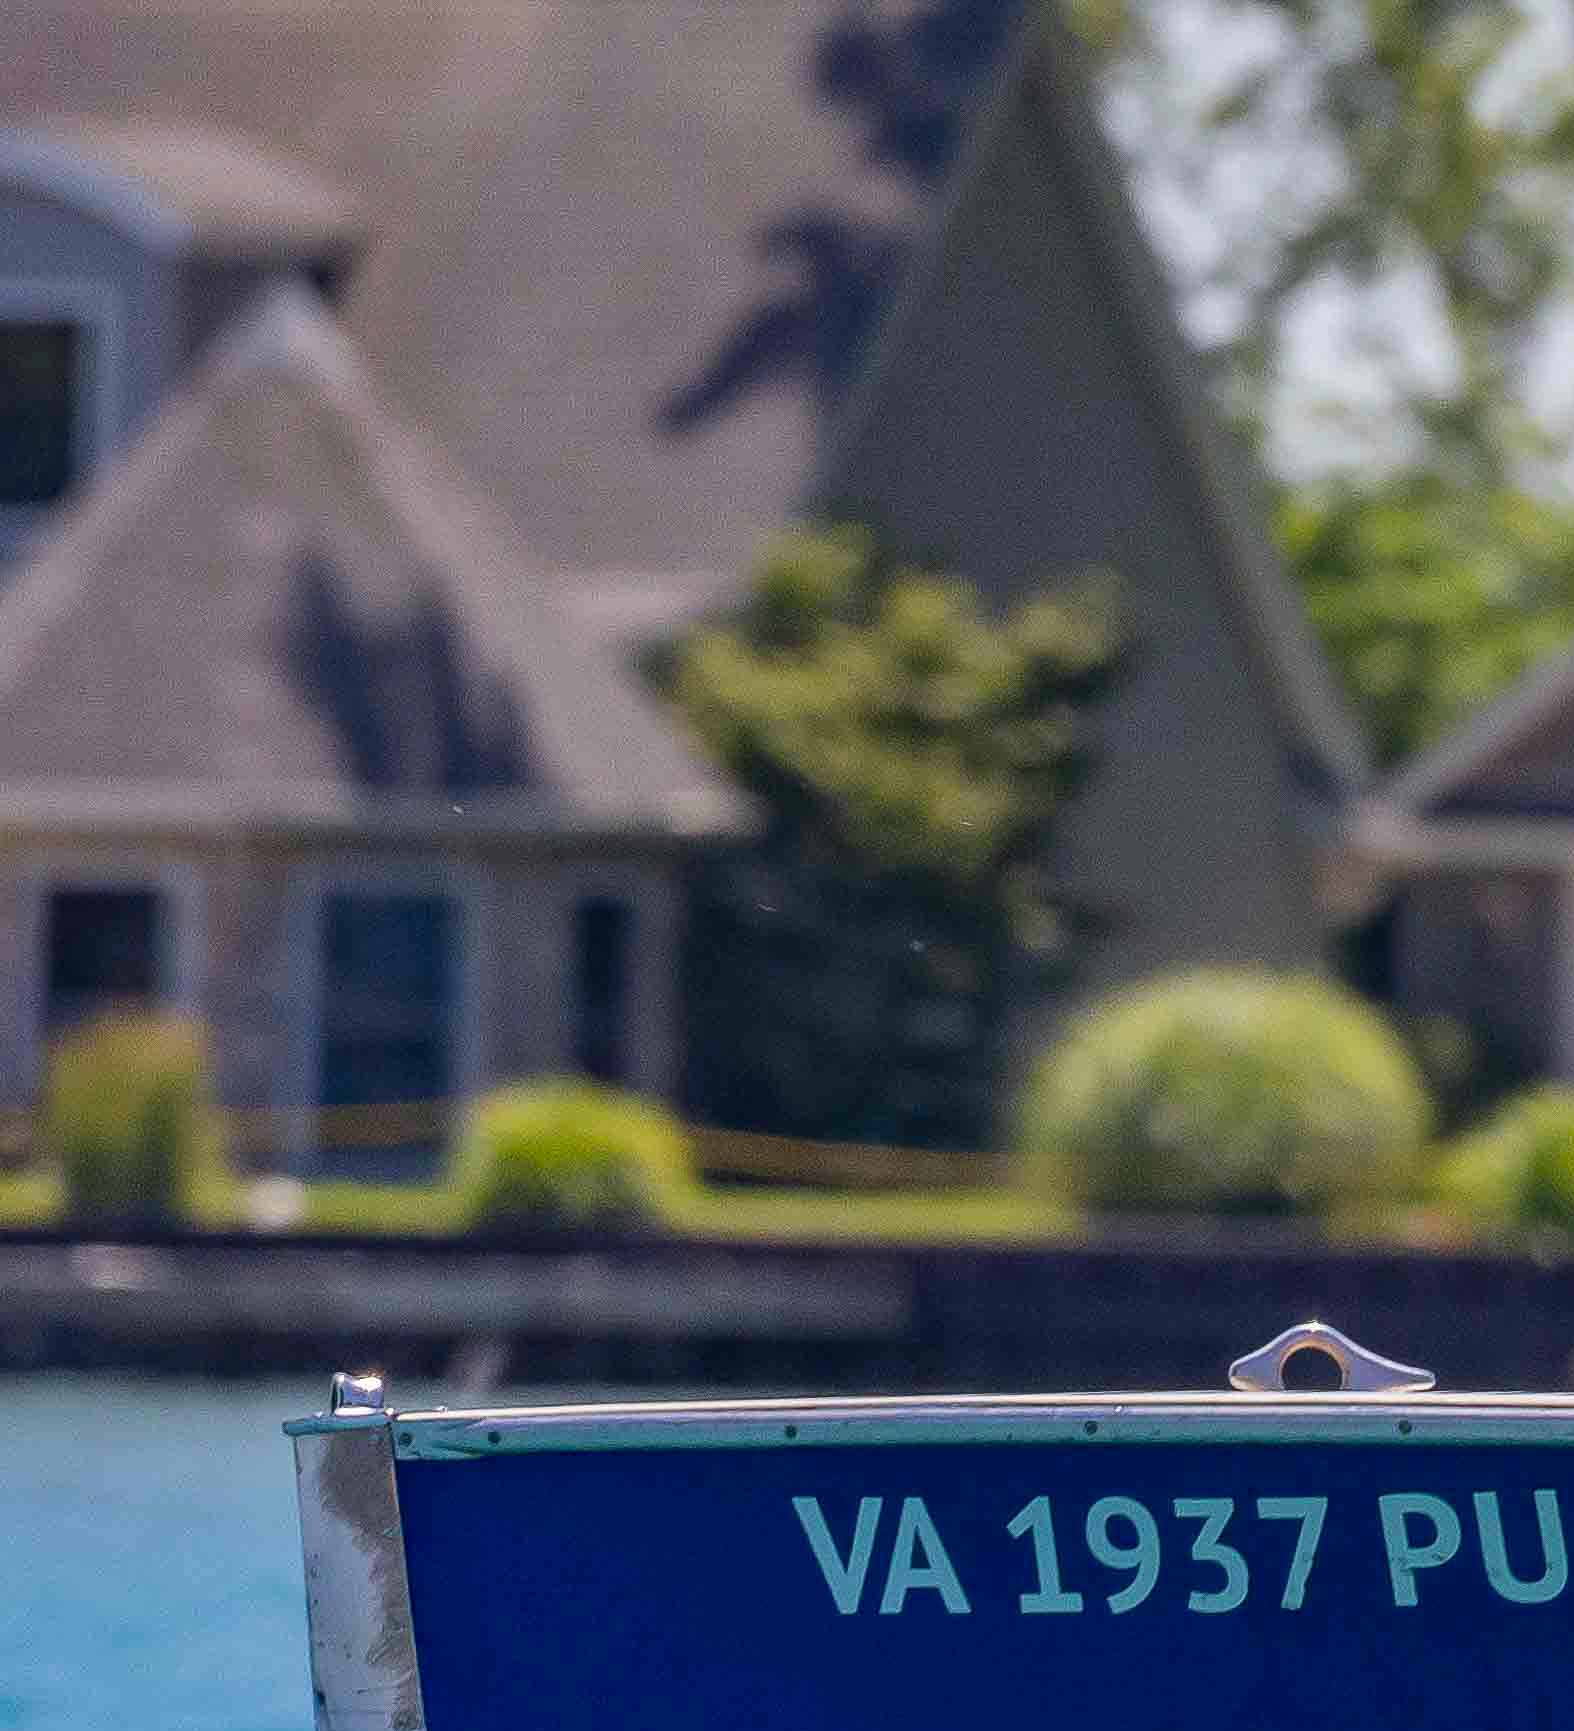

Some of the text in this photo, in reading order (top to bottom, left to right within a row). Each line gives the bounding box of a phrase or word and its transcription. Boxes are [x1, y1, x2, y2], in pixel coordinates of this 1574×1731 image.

[791, 1488, 1569, 1615] VA 1937 PU
